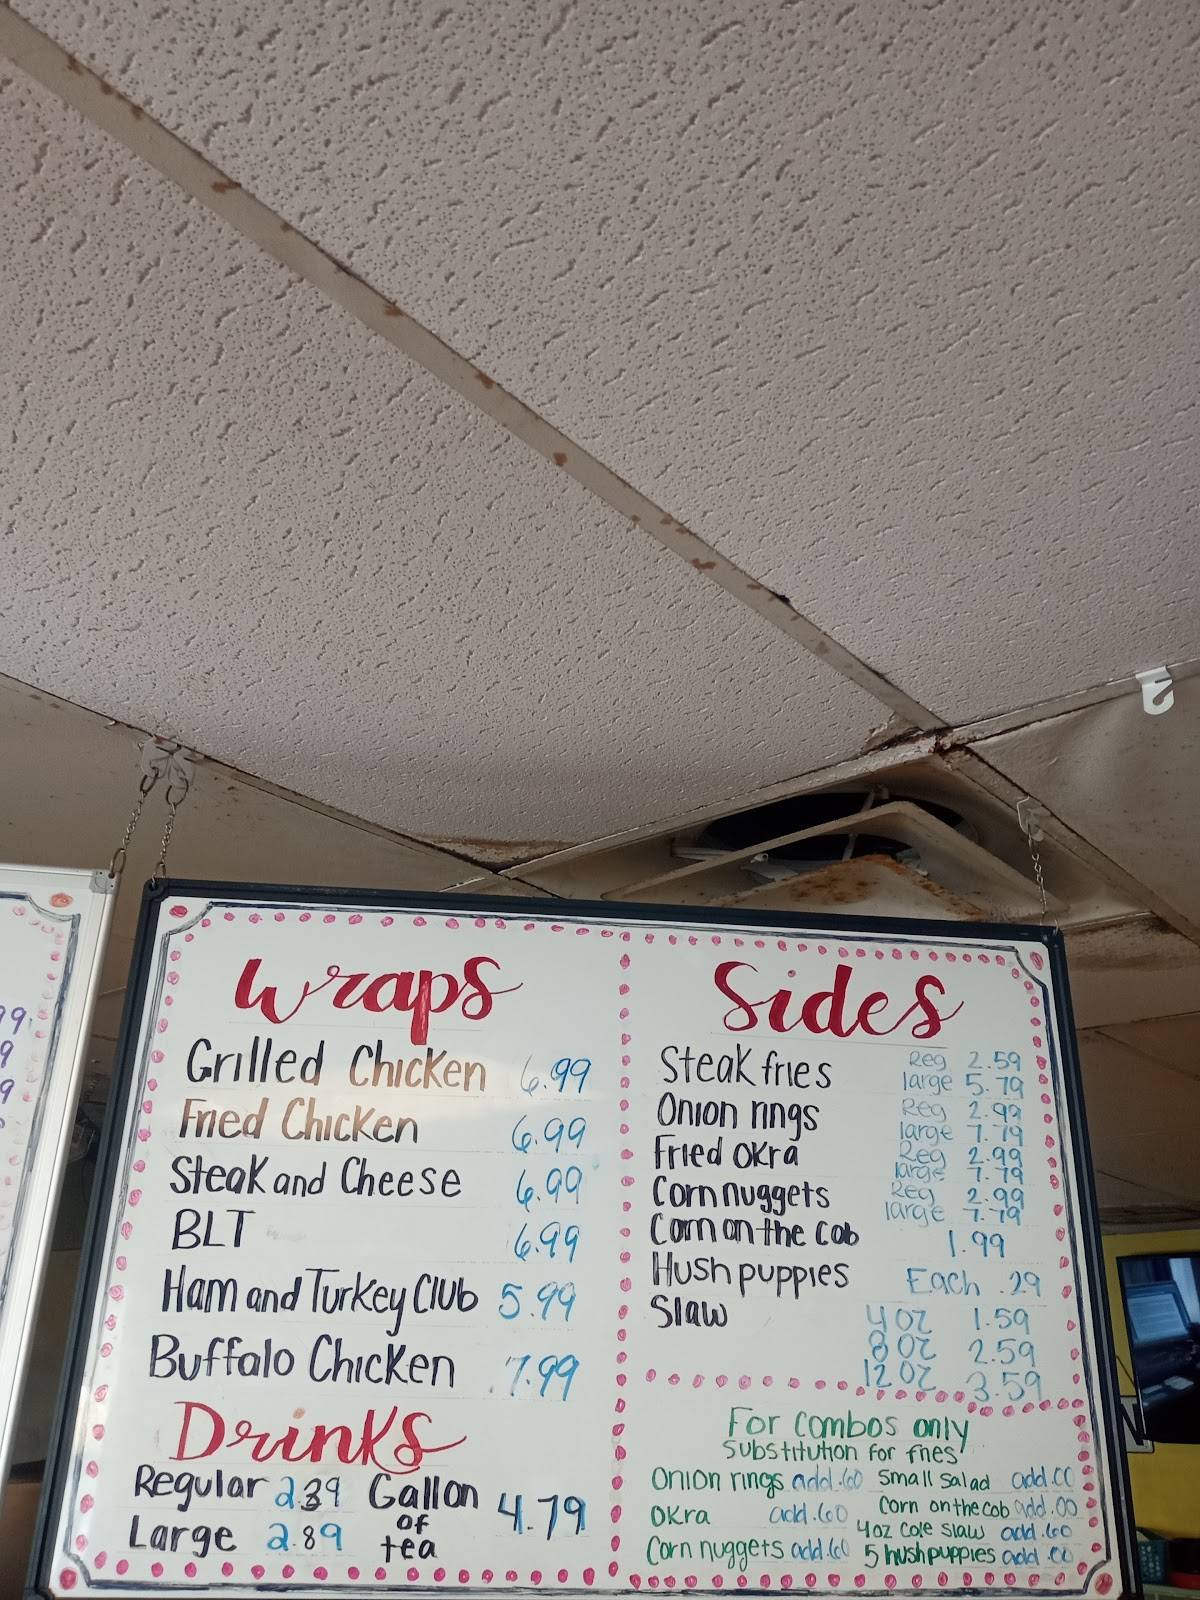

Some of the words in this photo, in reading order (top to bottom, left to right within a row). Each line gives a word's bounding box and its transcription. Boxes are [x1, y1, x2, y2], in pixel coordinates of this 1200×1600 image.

[235, 956, 523, 1045] Wraps
[714, 961, 965, 1039] Sides
[187, 1036, 324, 1085] Grilled
[350, 1040, 486, 1091] Chicken
[521, 1054, 592, 1096] 6.99
[661, 1043, 757, 1087] Steak
[761, 1050, 832, 1089] fries
[909, 1051, 947, 1071] Reg
[968, 1051, 1021, 1072] 2.59
[903, 1071, 953, 1096] large
[965, 1073, 1024, 1099] 5.79
[179, 1098, 268, 1140] Fried
[281, 1097, 418, 1143] Chicken
[512, 1114, 586, 1153] 6.99
[657, 1091, 738, 1129] Onion
[751, 1100, 820, 1142] rings
[902, 1097, 947, 1123] Reg
[969, 1100, 1022, 1123] 2.99
[900, 1121, 954, 1147] large
[967, 1124, 1023, 1147] 7.79
[654, 1134, 723, 1170] Fried
[899, 1140, 946, 1169] Reg
[968, 1146, 1023, 1168] 2.99
[895, 1162, 945, 1183] large
[966, 1166, 1024, 1185] 7.79
[170, 1154, 270, 1195] Steak
[276, 1161, 327, 1197] and
[341, 1156, 462, 1197] Cheese
[517, 1166, 583, 1212] 6.99
[652, 1175, 718, 1208] Corn
[722, 1181, 831, 1217] nuggets
[891, 1181, 935, 1206] Reg
[967, 1187, 1024, 1210] 2.99
[172, 1208, 255, 1250] BLT
[514, 1221, 580, 1263] 6.99
[650, 1212, 717, 1246] Corn
[723, 1218, 755, 1245] on
[755, 1217, 807, 1247] the
[948, 1229, 1005, 1258] 1.99
[885, 1201, 945, 1227] large
[963, 1206, 1021, 1226] 7.79
[652, 1251, 732, 1287] Hush
[739, 1262, 850, 1300] puppies
[906, 1267, 981, 1297] Each
[1000, 1270, 1041, 1297] .29
[162, 1265, 239, 1313] Ham
[246, 1276, 301, 1313] and
[305, 1267, 407, 1336] Turkey
[413, 1274, 479, 1313] Club
[499, 1281, 576, 1322] 5.99
[650, 1294, 728, 1329] Slaw
[974, 1307, 1030, 1335] 1.59
[149, 1335, 295, 1382] Buffalo
[309, 1334, 456, 1388] Chicken
[506, 1354, 580, 1401] 7.99
[968, 1338, 1036, 1368] 2.59
[864, 1358, 892, 1388] 12
[966, 1370, 1042, 1402] 3.59
[169, 1401, 467, 1475] Drinks
[728, 1406, 781, 1438] For
[913, 1416, 969, 1453] only
[869, 1443, 896, 1461] for
[906, 1444, 958, 1464] fries
[134, 1464, 270, 1512] Regular
[651, 1467, 721, 1491] Onion
[730, 1471, 785, 1499] rings
[368, 1472, 479, 1510] Gallon
[498, 1492, 586, 1541] 4.79
[396, 1514, 429, 1535] of
[929, 1500, 950, 1513] on
[129, 1515, 237, 1558] Large
[267, 1522, 343, 1551] 2.89
[380, 1535, 438, 1563] tea
[646, 1535, 693, 1566] Corn
[700, 1538, 785, 1572] nuggets
[864, 1544, 879, 1568] 5
